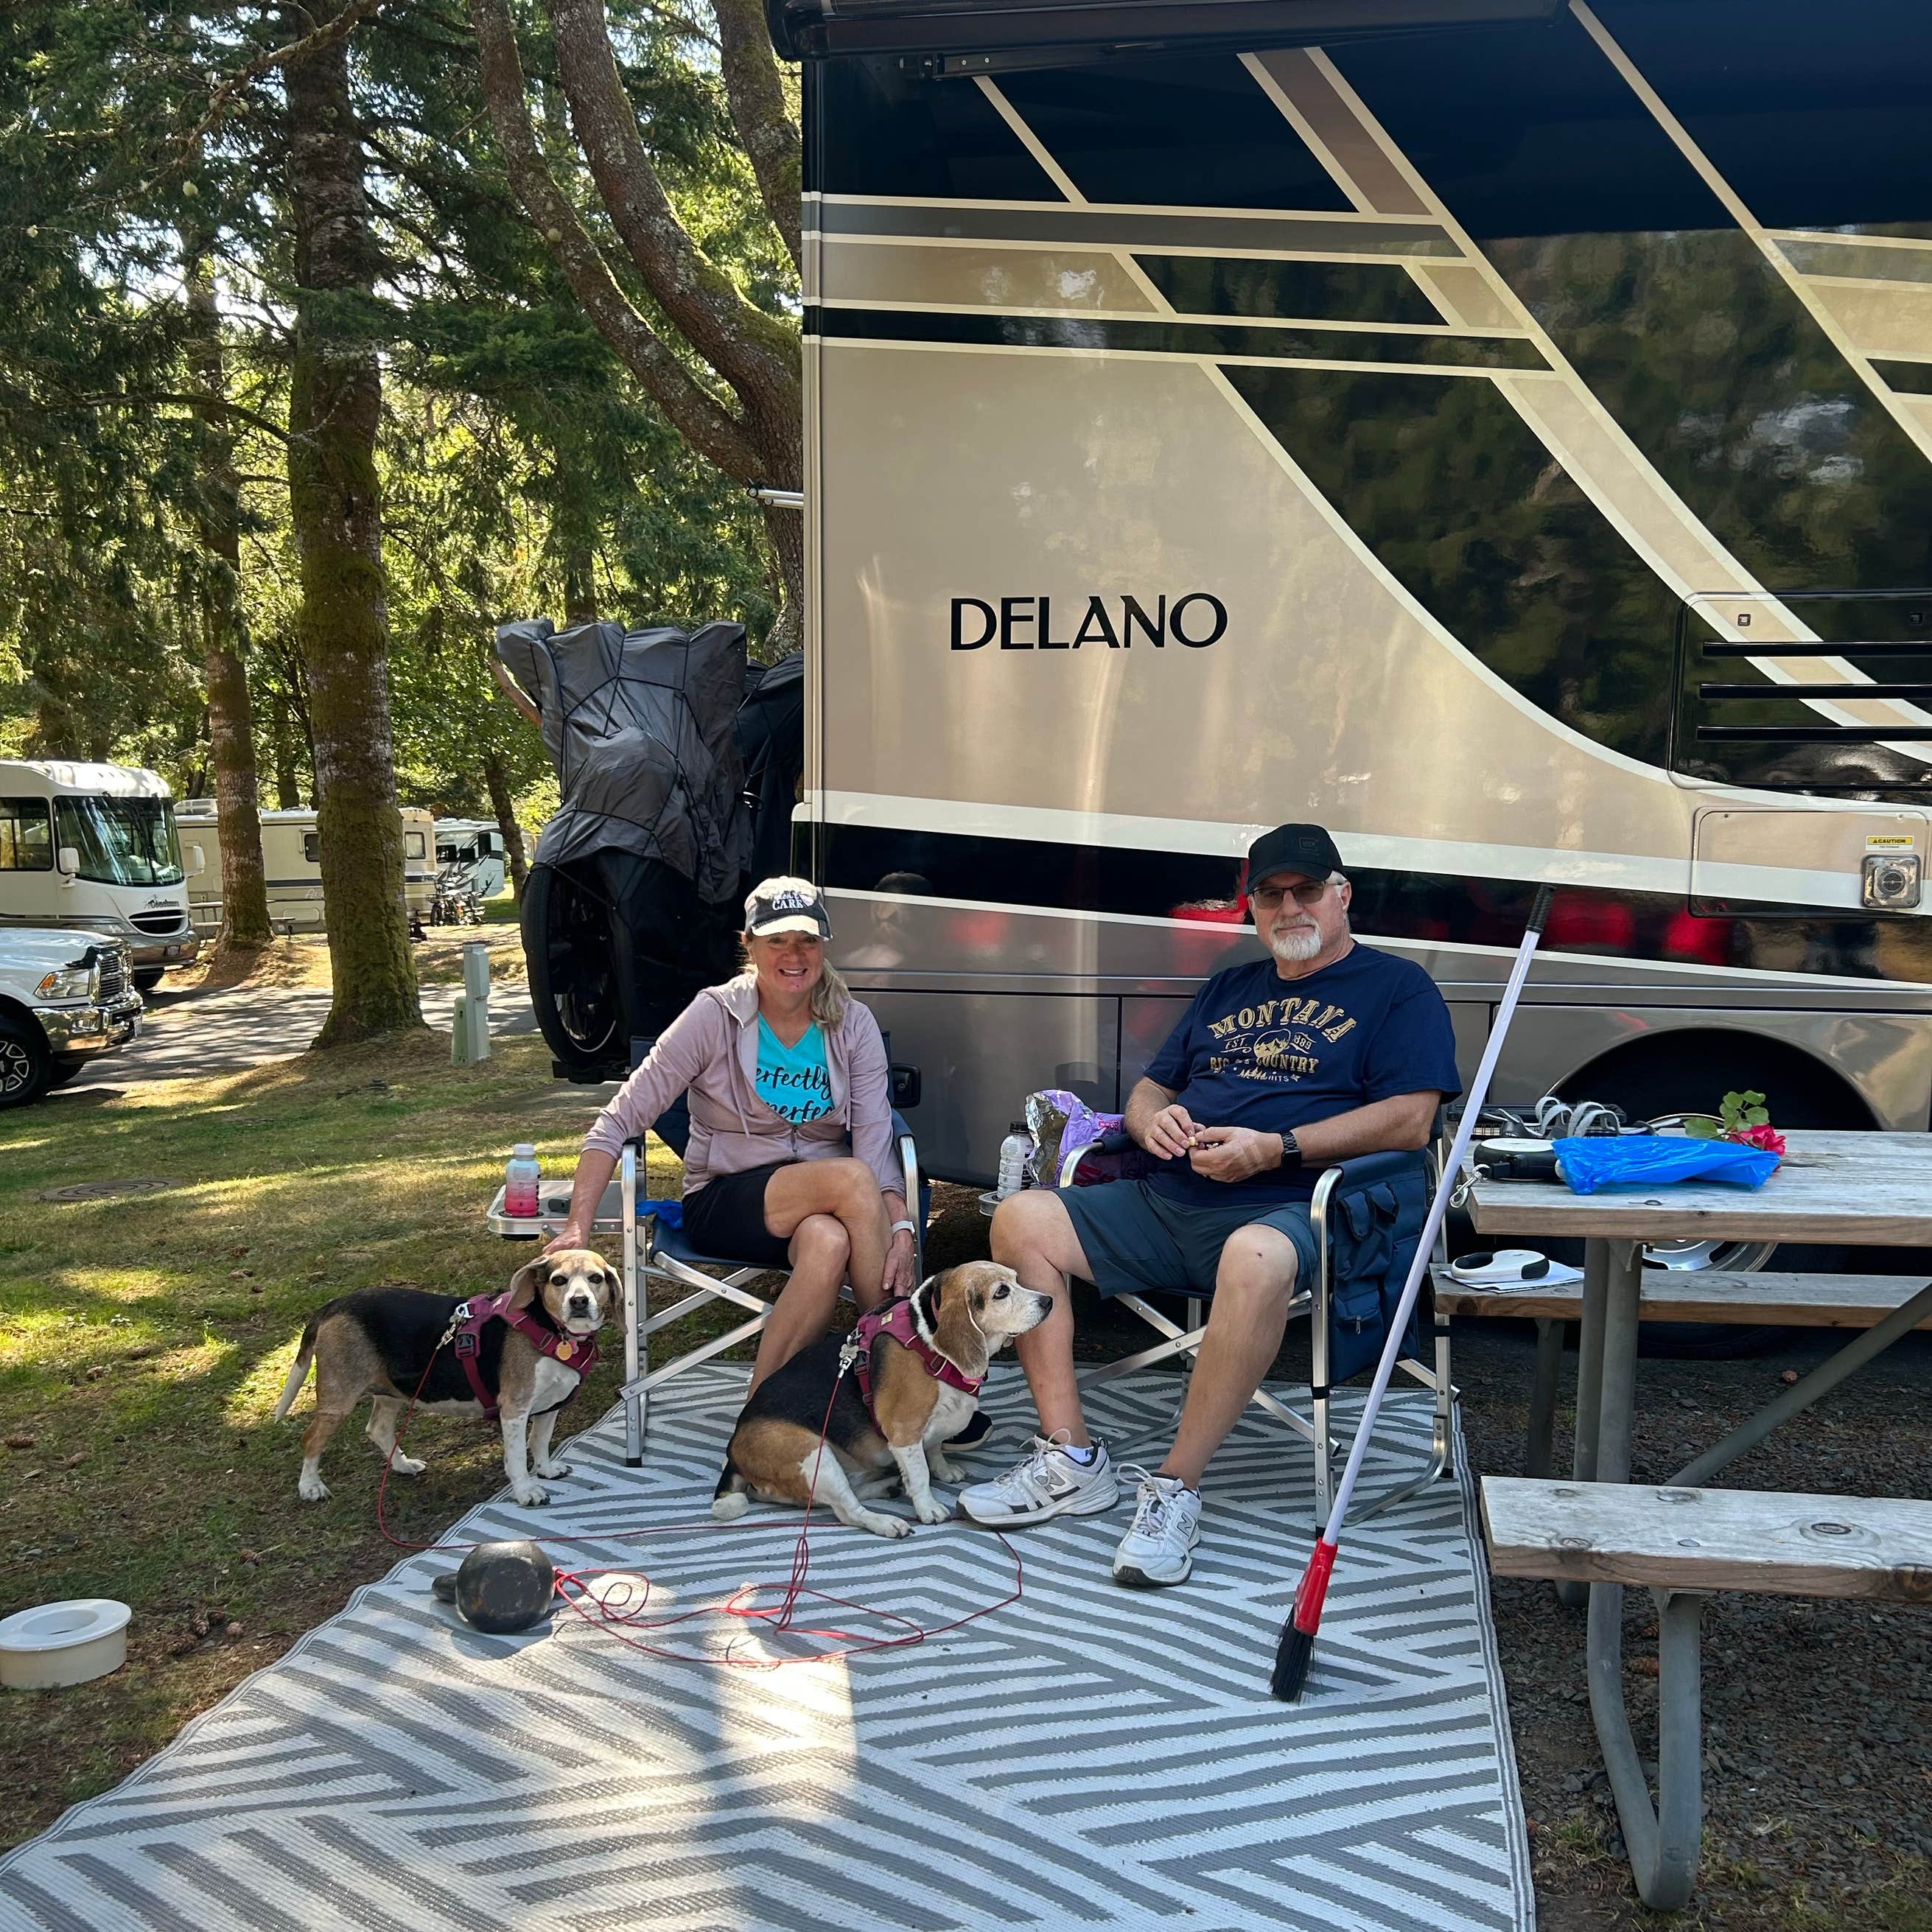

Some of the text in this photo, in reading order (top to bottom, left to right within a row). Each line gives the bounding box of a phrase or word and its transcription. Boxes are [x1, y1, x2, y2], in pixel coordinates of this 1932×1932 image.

[951, 592, 1228, 651] DELANO
[772, 899, 804, 911] CARE
[1207, 997, 1357, 1043] MONTANA
[1225, 1037, 1248, 1049] EST.
[756, 1065, 831, 1101] erfectly
